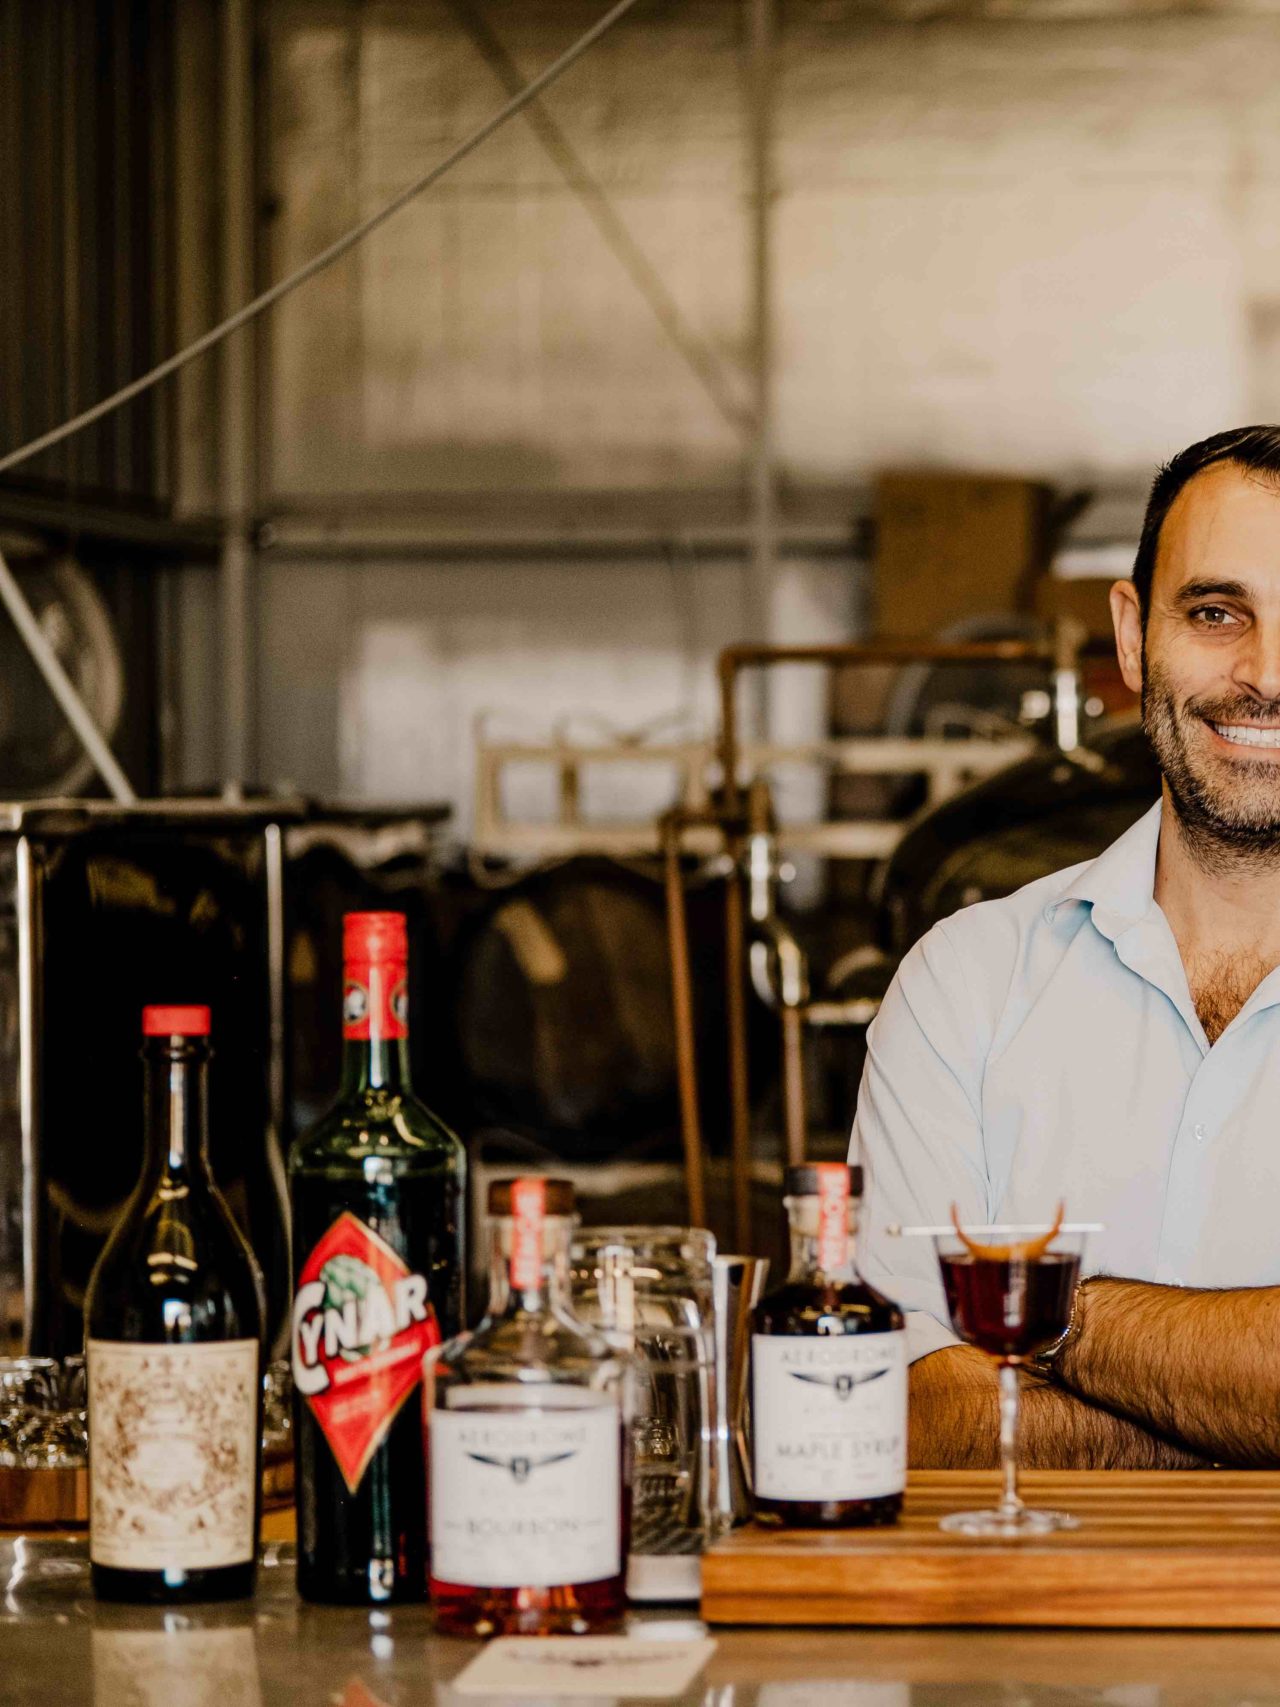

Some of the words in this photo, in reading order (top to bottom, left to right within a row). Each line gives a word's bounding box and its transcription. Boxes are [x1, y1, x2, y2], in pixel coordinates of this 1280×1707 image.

[292, 1274, 428, 1396] CYNAR
[781, 1345, 898, 1366] AERODROME
[457, 1427, 587, 1445] AERODROME
[776, 1441, 842, 1462] MAPLE
[464, 1517, 581, 1537] BOURBON
